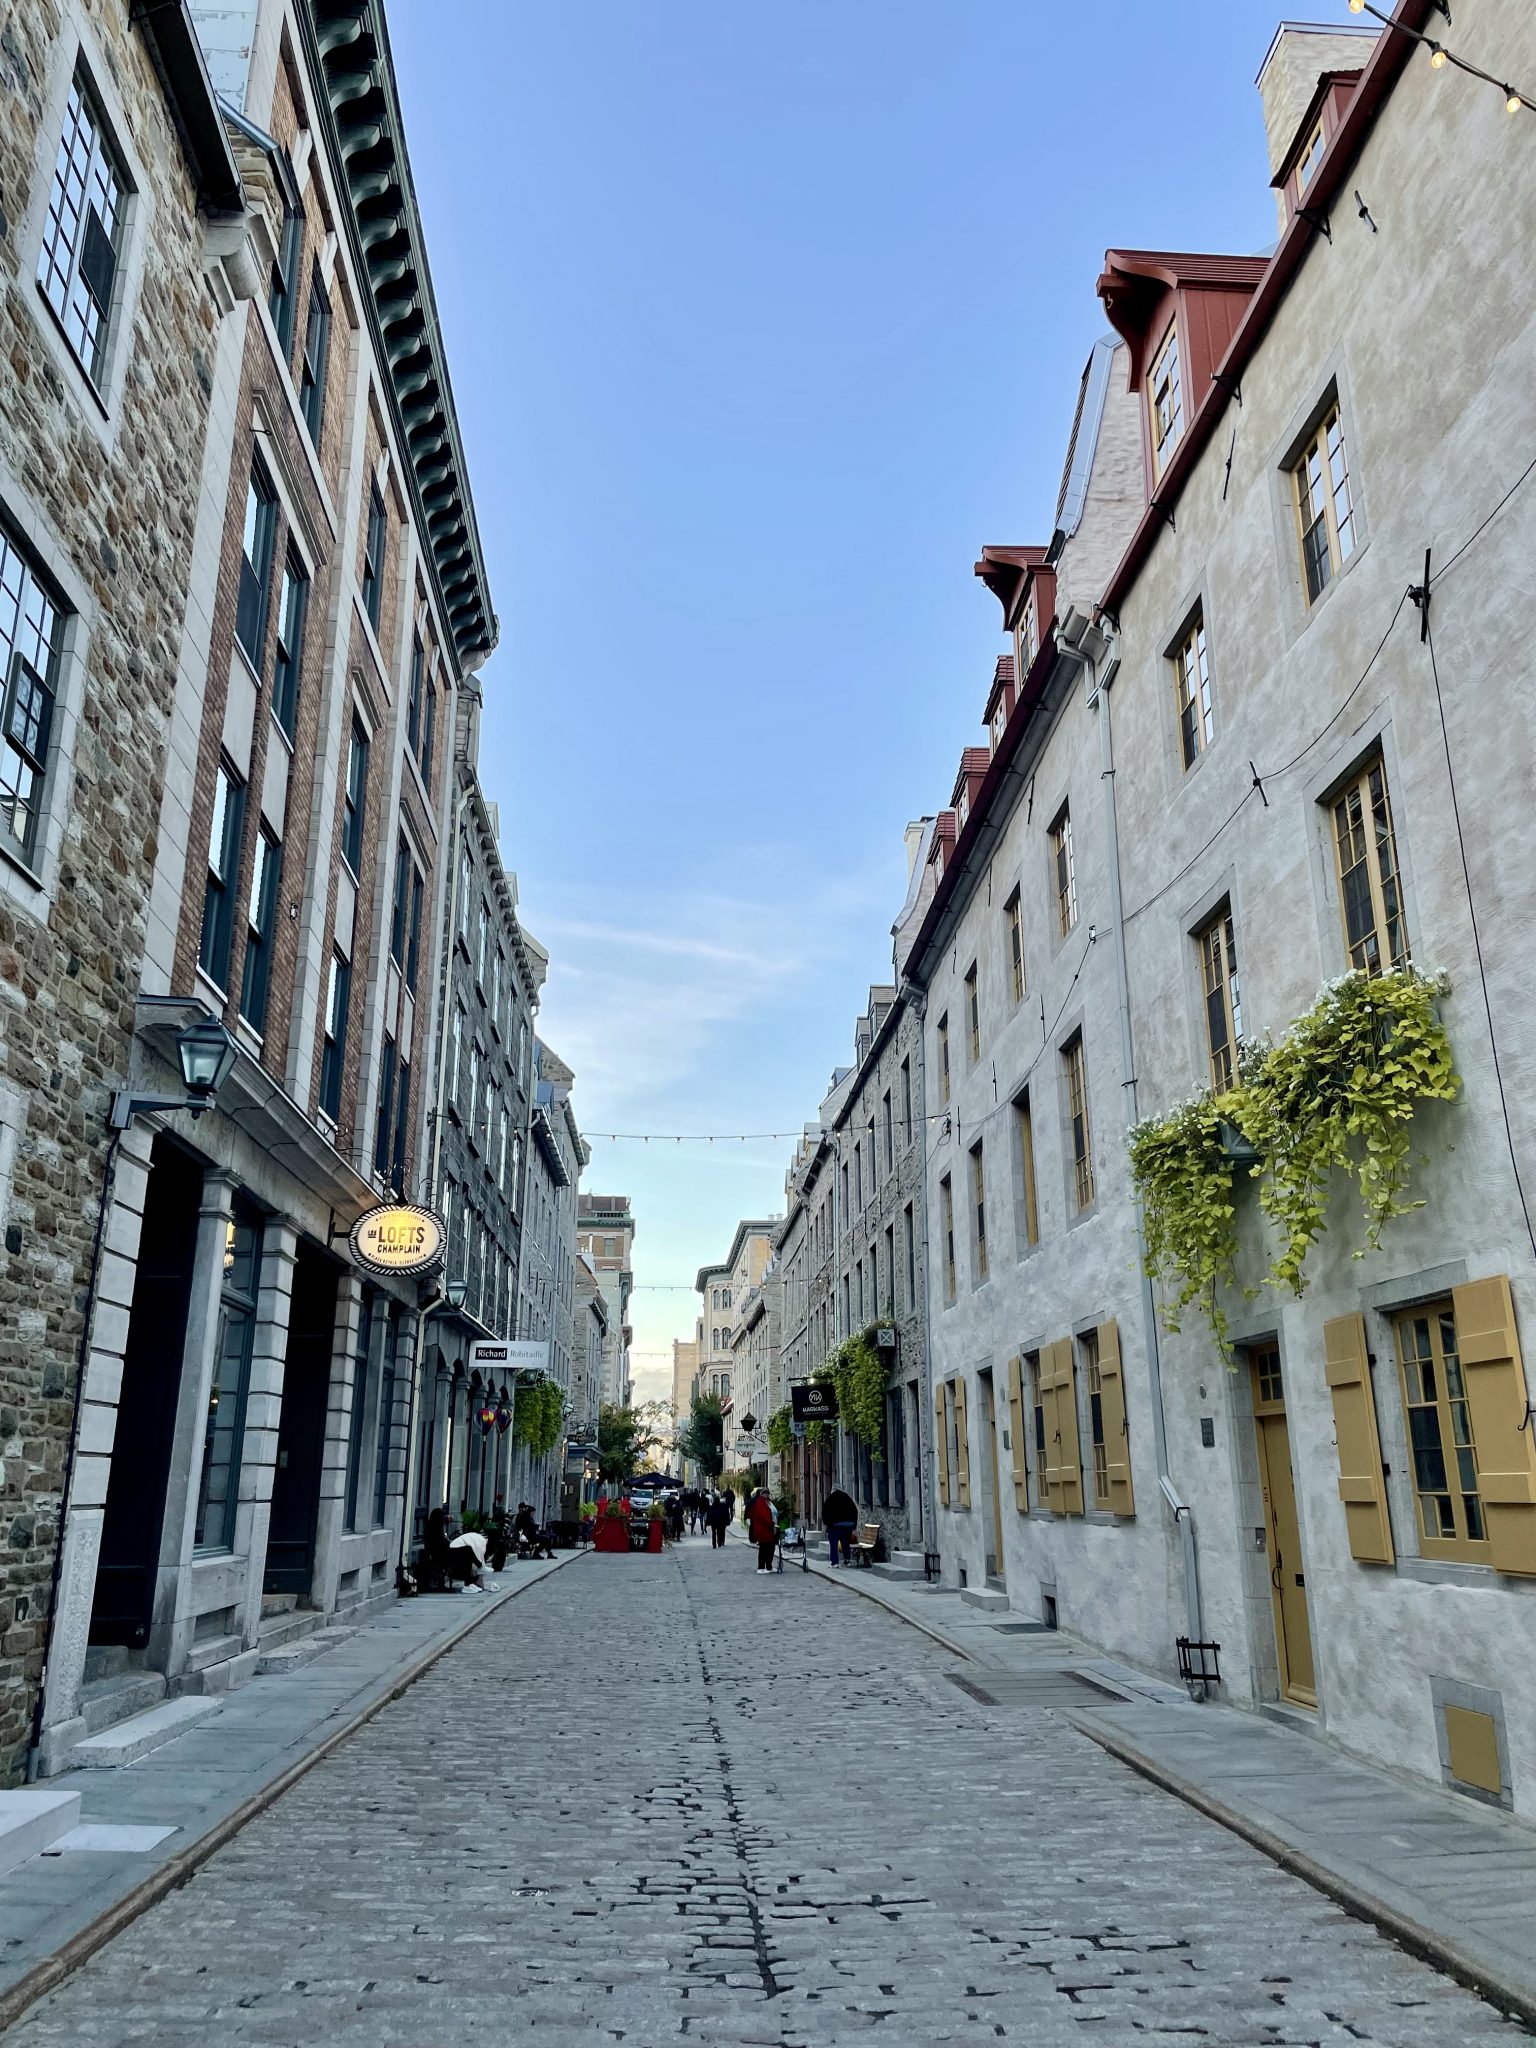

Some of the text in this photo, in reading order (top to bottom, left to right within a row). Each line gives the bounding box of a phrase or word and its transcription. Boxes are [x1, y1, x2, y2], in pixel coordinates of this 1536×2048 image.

[379, 1226, 425, 1243] LOFTS
[378, 1245, 421, 1253] CHAMPLAIN
[478, 1349, 544, 1358] Richard Robitaille
